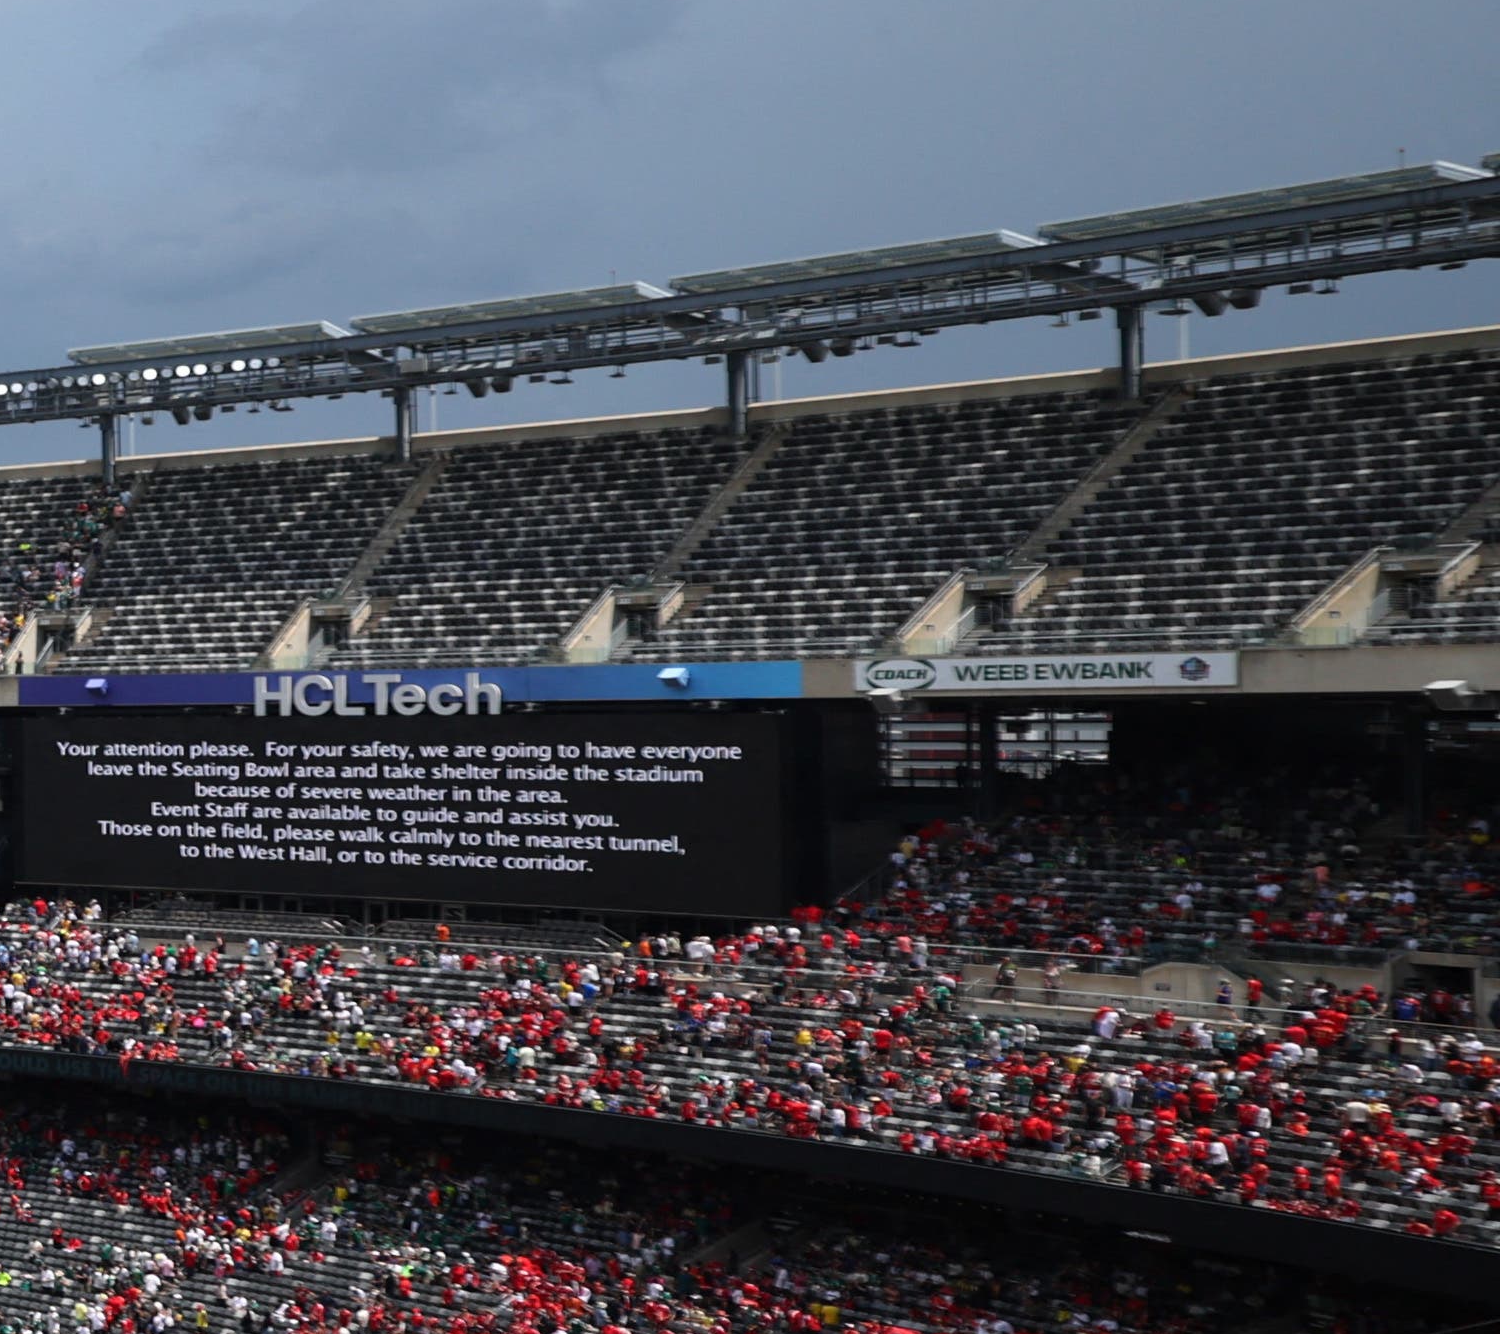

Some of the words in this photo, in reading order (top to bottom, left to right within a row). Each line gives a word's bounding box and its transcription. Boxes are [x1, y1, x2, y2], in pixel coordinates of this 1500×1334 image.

[874, 667, 928, 680] COACH
[954, 665, 1030, 681] WEEB
[1034, 661, 1154, 680] EWBANK
[253, 672, 502, 717] HCLTech
[151, 801, 201, 817] Event
[204, 801, 249, 818] Staff
[252, 806, 283, 819] are
[286, 804, 372, 821] available
[376, 807, 398, 822] to
[401, 806, 459, 826] guide
[463, 808, 504, 824] and
[508, 810, 569, 826] assist
[572, 814, 620, 830] you.
[179, 844, 200, 858] to
[203, 843, 235, 859] the
[237, 844, 285, 861] West
[289, 846, 333, 864] Hall,
[337, 850, 360, 863] or
[363, 850, 385, 864] to
[389, 849, 422, 866] the
[427, 852, 498, 869] service
[502, 854, 594, 872] corridor.
